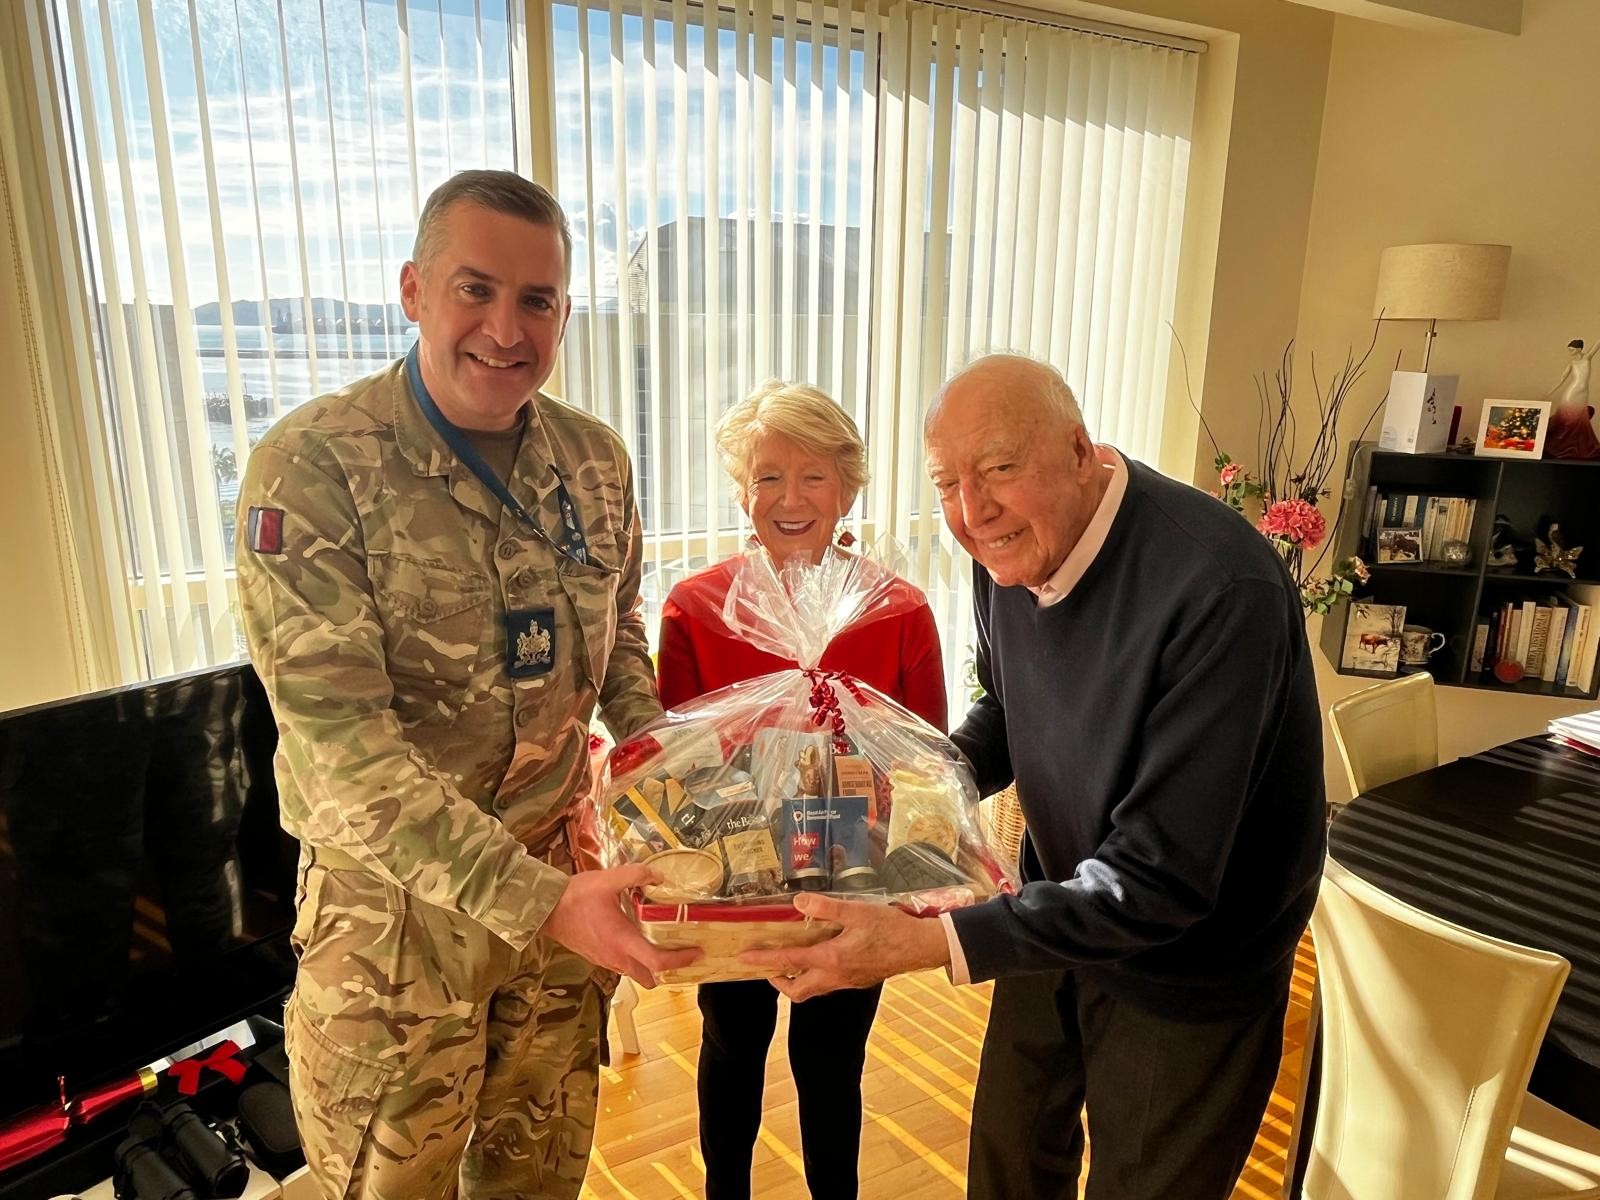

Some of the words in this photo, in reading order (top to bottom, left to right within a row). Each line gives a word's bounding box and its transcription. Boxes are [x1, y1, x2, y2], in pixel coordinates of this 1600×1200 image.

[726, 818, 741, 829] the
[793, 837, 816, 846] How
[793, 853, 809, 861] we
